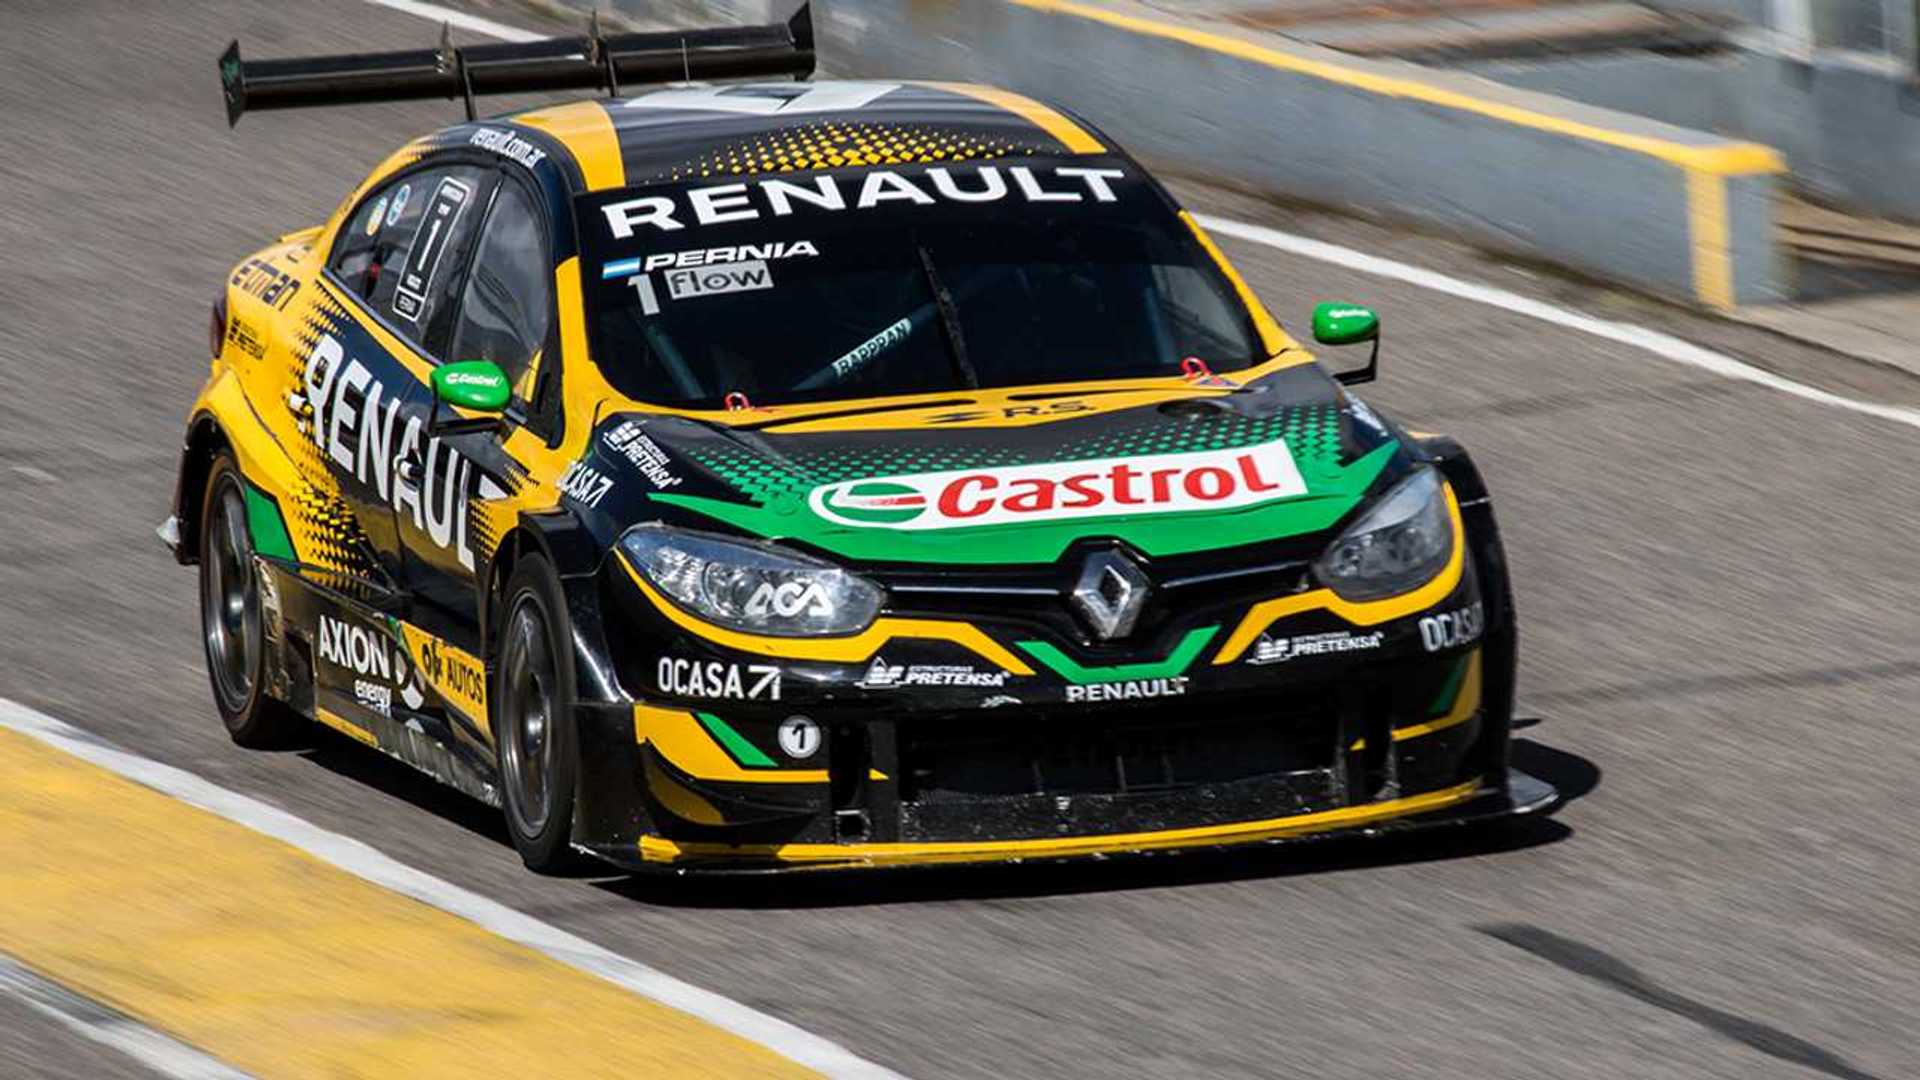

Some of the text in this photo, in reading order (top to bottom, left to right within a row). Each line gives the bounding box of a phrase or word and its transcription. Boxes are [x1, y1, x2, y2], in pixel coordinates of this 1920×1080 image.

[601, 167, 1124, 239] RENAULT
[644, 240, 819, 272] PERNIA
[628, 274, 662, 317] 1
[670, 267, 768, 296] flow
[938, 454, 1280, 519] Castrol
[744, 581, 834, 617] ACA
[320, 615, 390, 679] AXION
[1292, 637, 1380, 656] PRETENSA
[355, 678, 392, 709] energy
[447, 656, 484, 704] AUTOS
[905, 672, 1003, 687] PRETENSA
[1065, 677, 1190, 703] RENAULT
